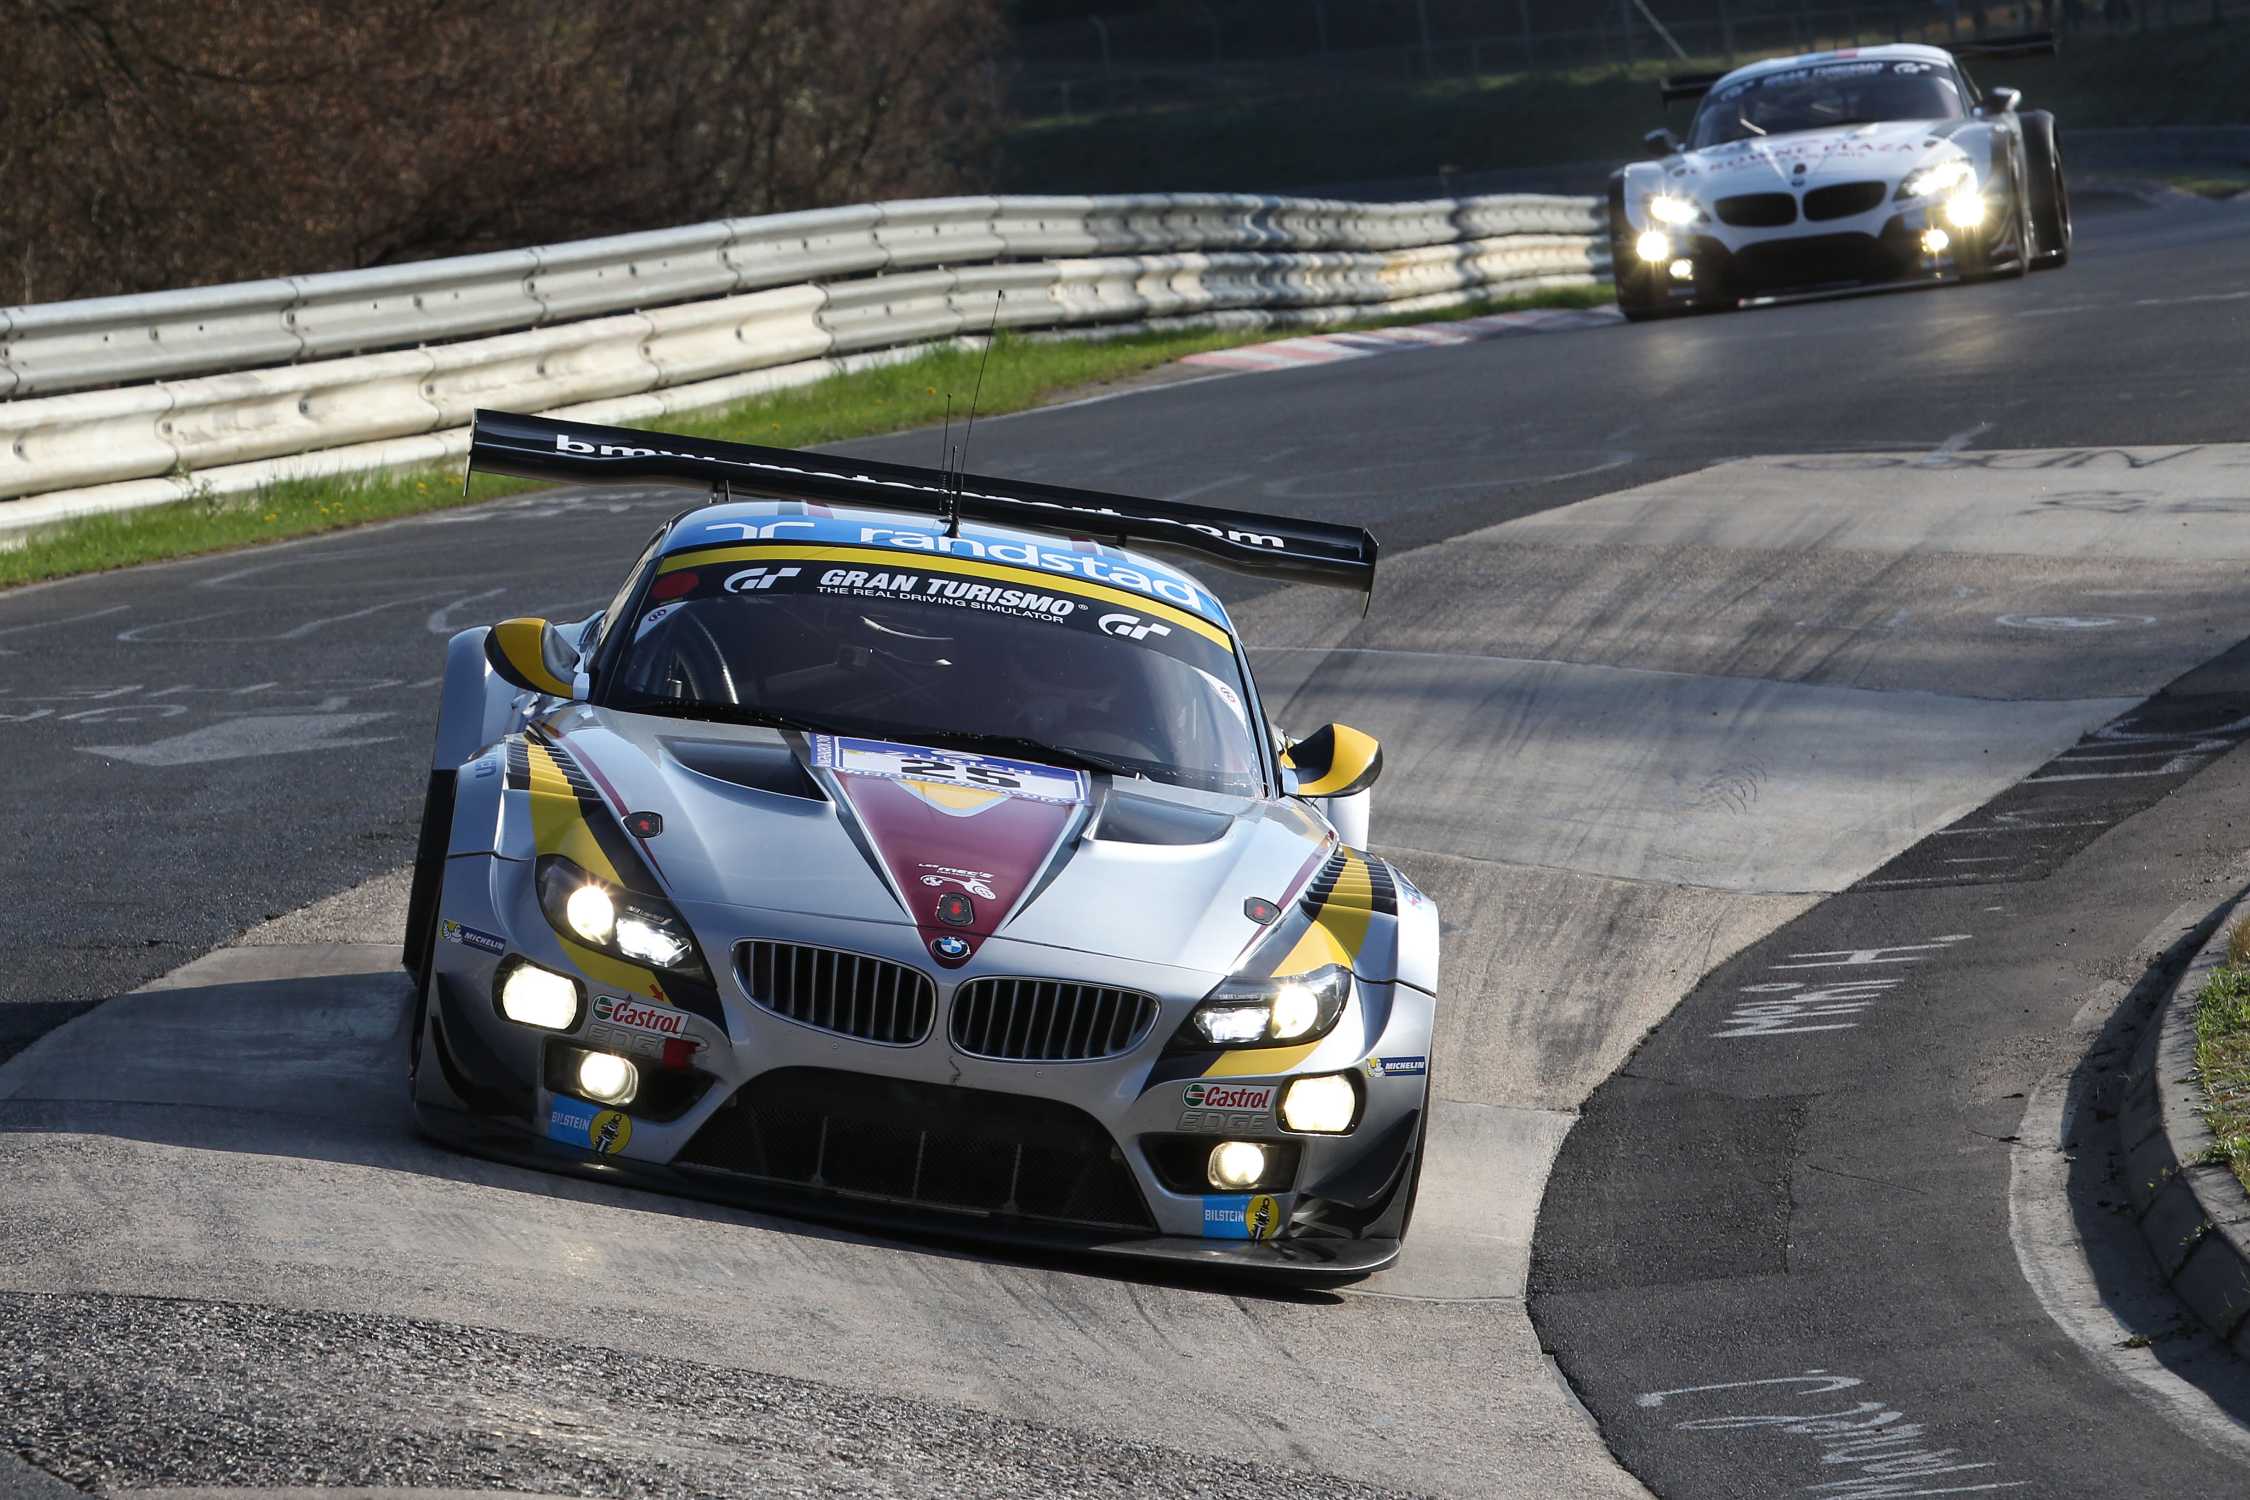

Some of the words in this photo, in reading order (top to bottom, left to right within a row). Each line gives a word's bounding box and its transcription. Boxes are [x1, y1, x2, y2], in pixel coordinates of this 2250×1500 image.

[860, 527, 1202, 610] randstad
[819, 568, 917, 593] GRAN
[927, 577, 1075, 617] TURISMO
[816, 586, 850, 597] THE
[853, 587, 897, 600] REAL
[899, 590, 967, 608] DRIVING
[969, 600, 1065, 625] SIMULATOR
[463, 930, 505, 950] MICHELIN
[612, 1000, 682, 1034] Castrol
[1385, 1061, 1425, 1070] MICHELIN
[1204, 1086, 1270, 1109] Castrol
[551, 1111, 590, 1131] BILSTEIN
[1176, 1111, 1270, 1134] EDGE
[1204, 1209, 1244, 1223] BILSTEIN
